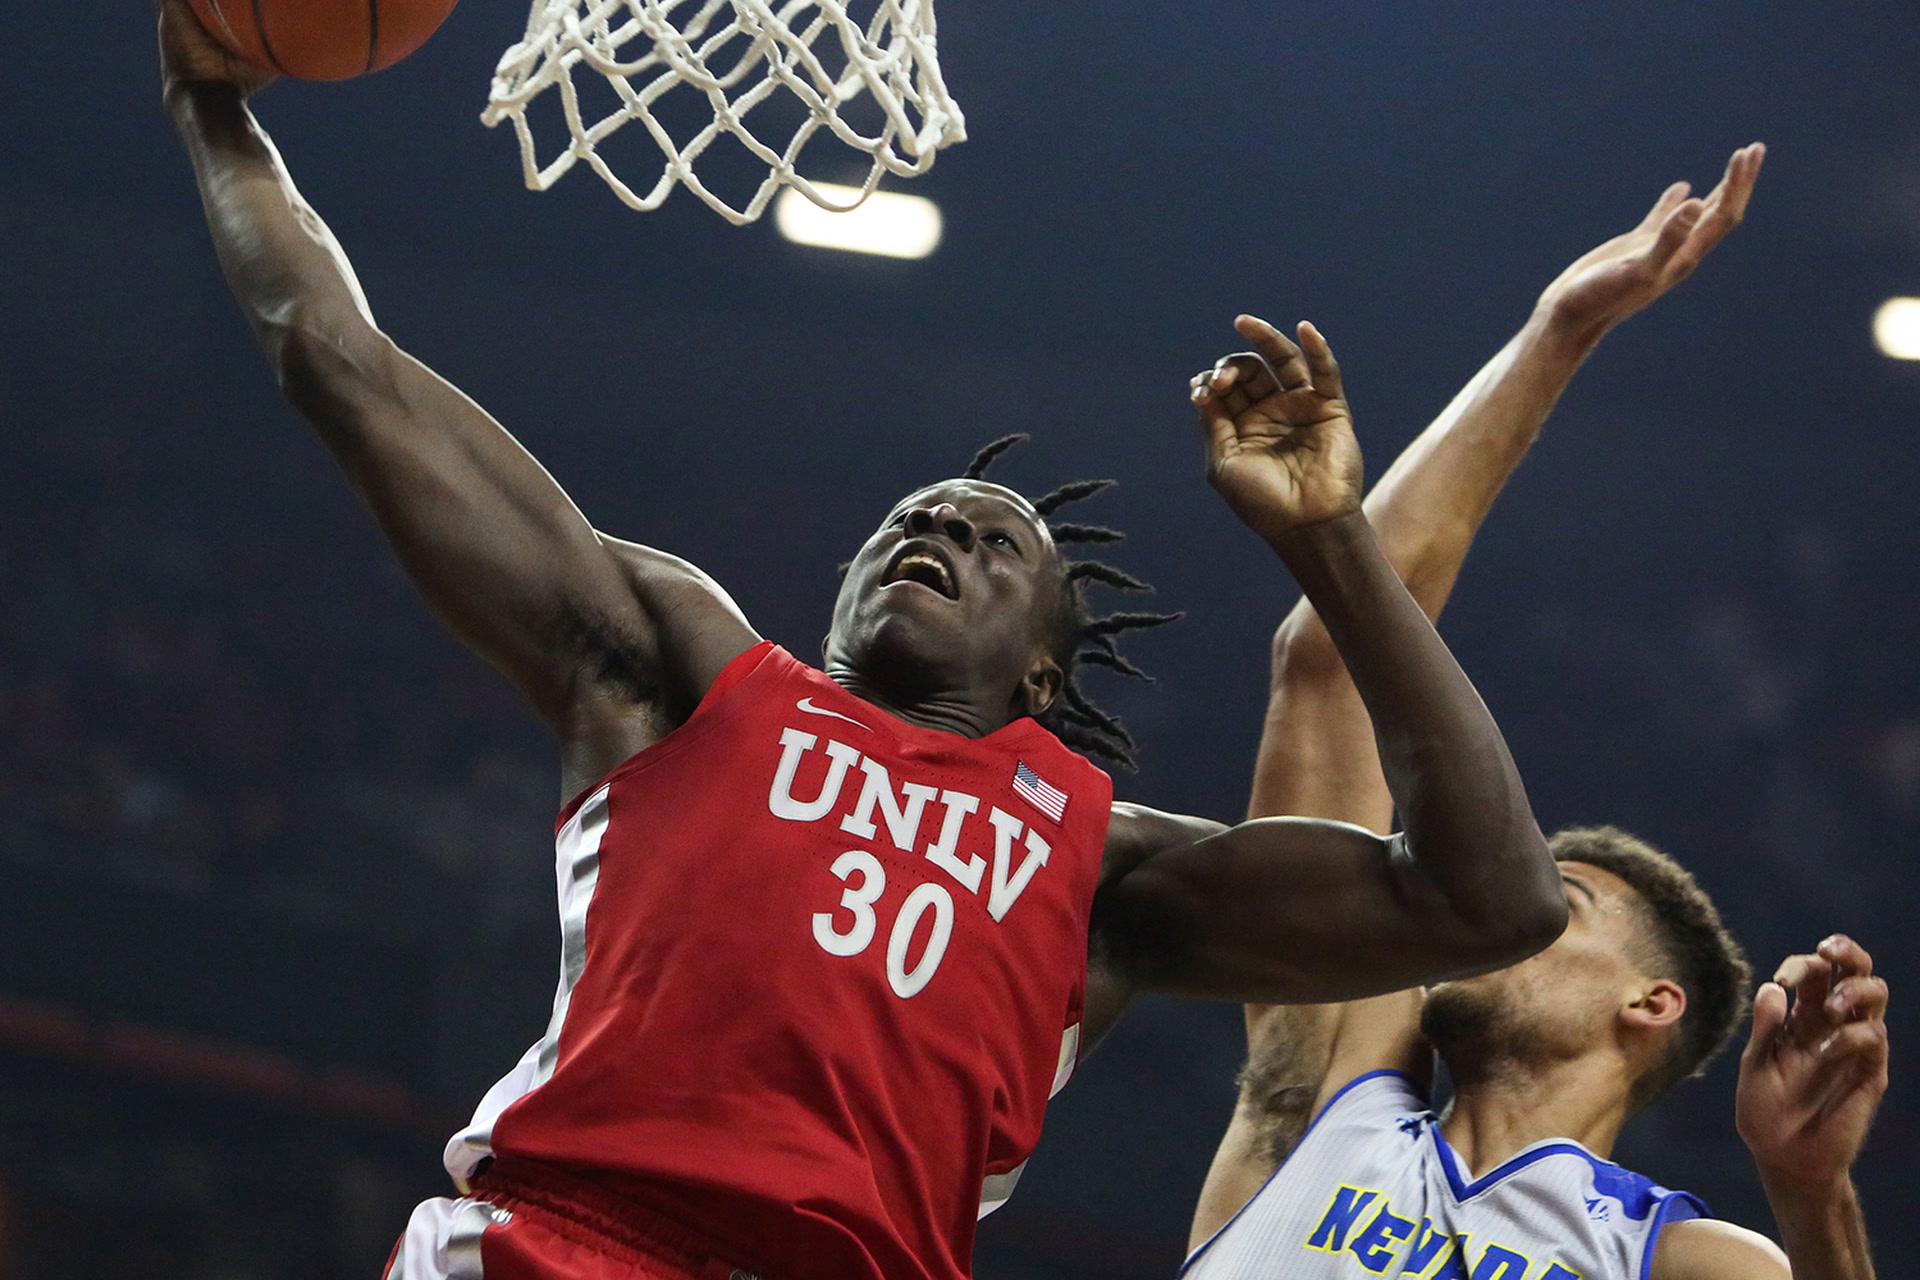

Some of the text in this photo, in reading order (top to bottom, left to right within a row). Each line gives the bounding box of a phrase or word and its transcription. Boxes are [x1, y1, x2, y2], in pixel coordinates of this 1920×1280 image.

[768, 727, 1052, 923] UNLV
[812, 850, 954, 999] 30
[1302, 1183, 1583, 1280] NEVAD
